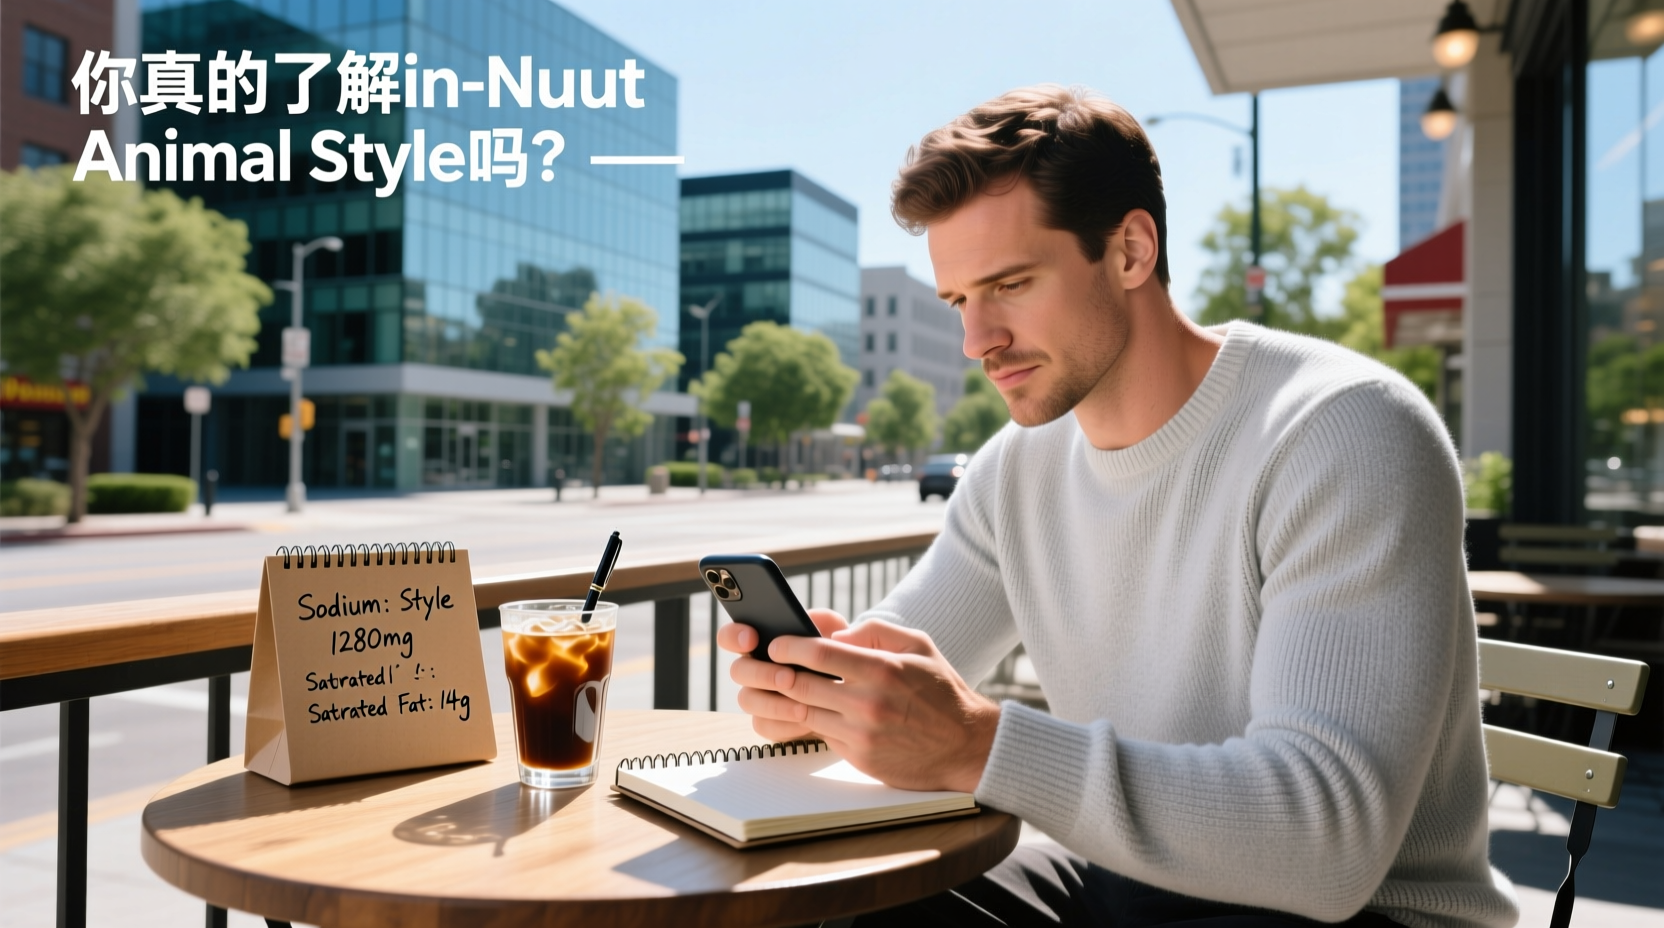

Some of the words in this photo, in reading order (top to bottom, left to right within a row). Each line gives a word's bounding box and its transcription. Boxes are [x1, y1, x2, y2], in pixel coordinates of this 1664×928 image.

[297, 592, 390, 621] Sodium:
[400, 585, 455, 621] Style
[331, 627, 413, 659] 1280mg
[308, 695, 388, 724] Satrated
[398, 692, 433, 715] Fat:
[440, 688, 470, 722] 14g
